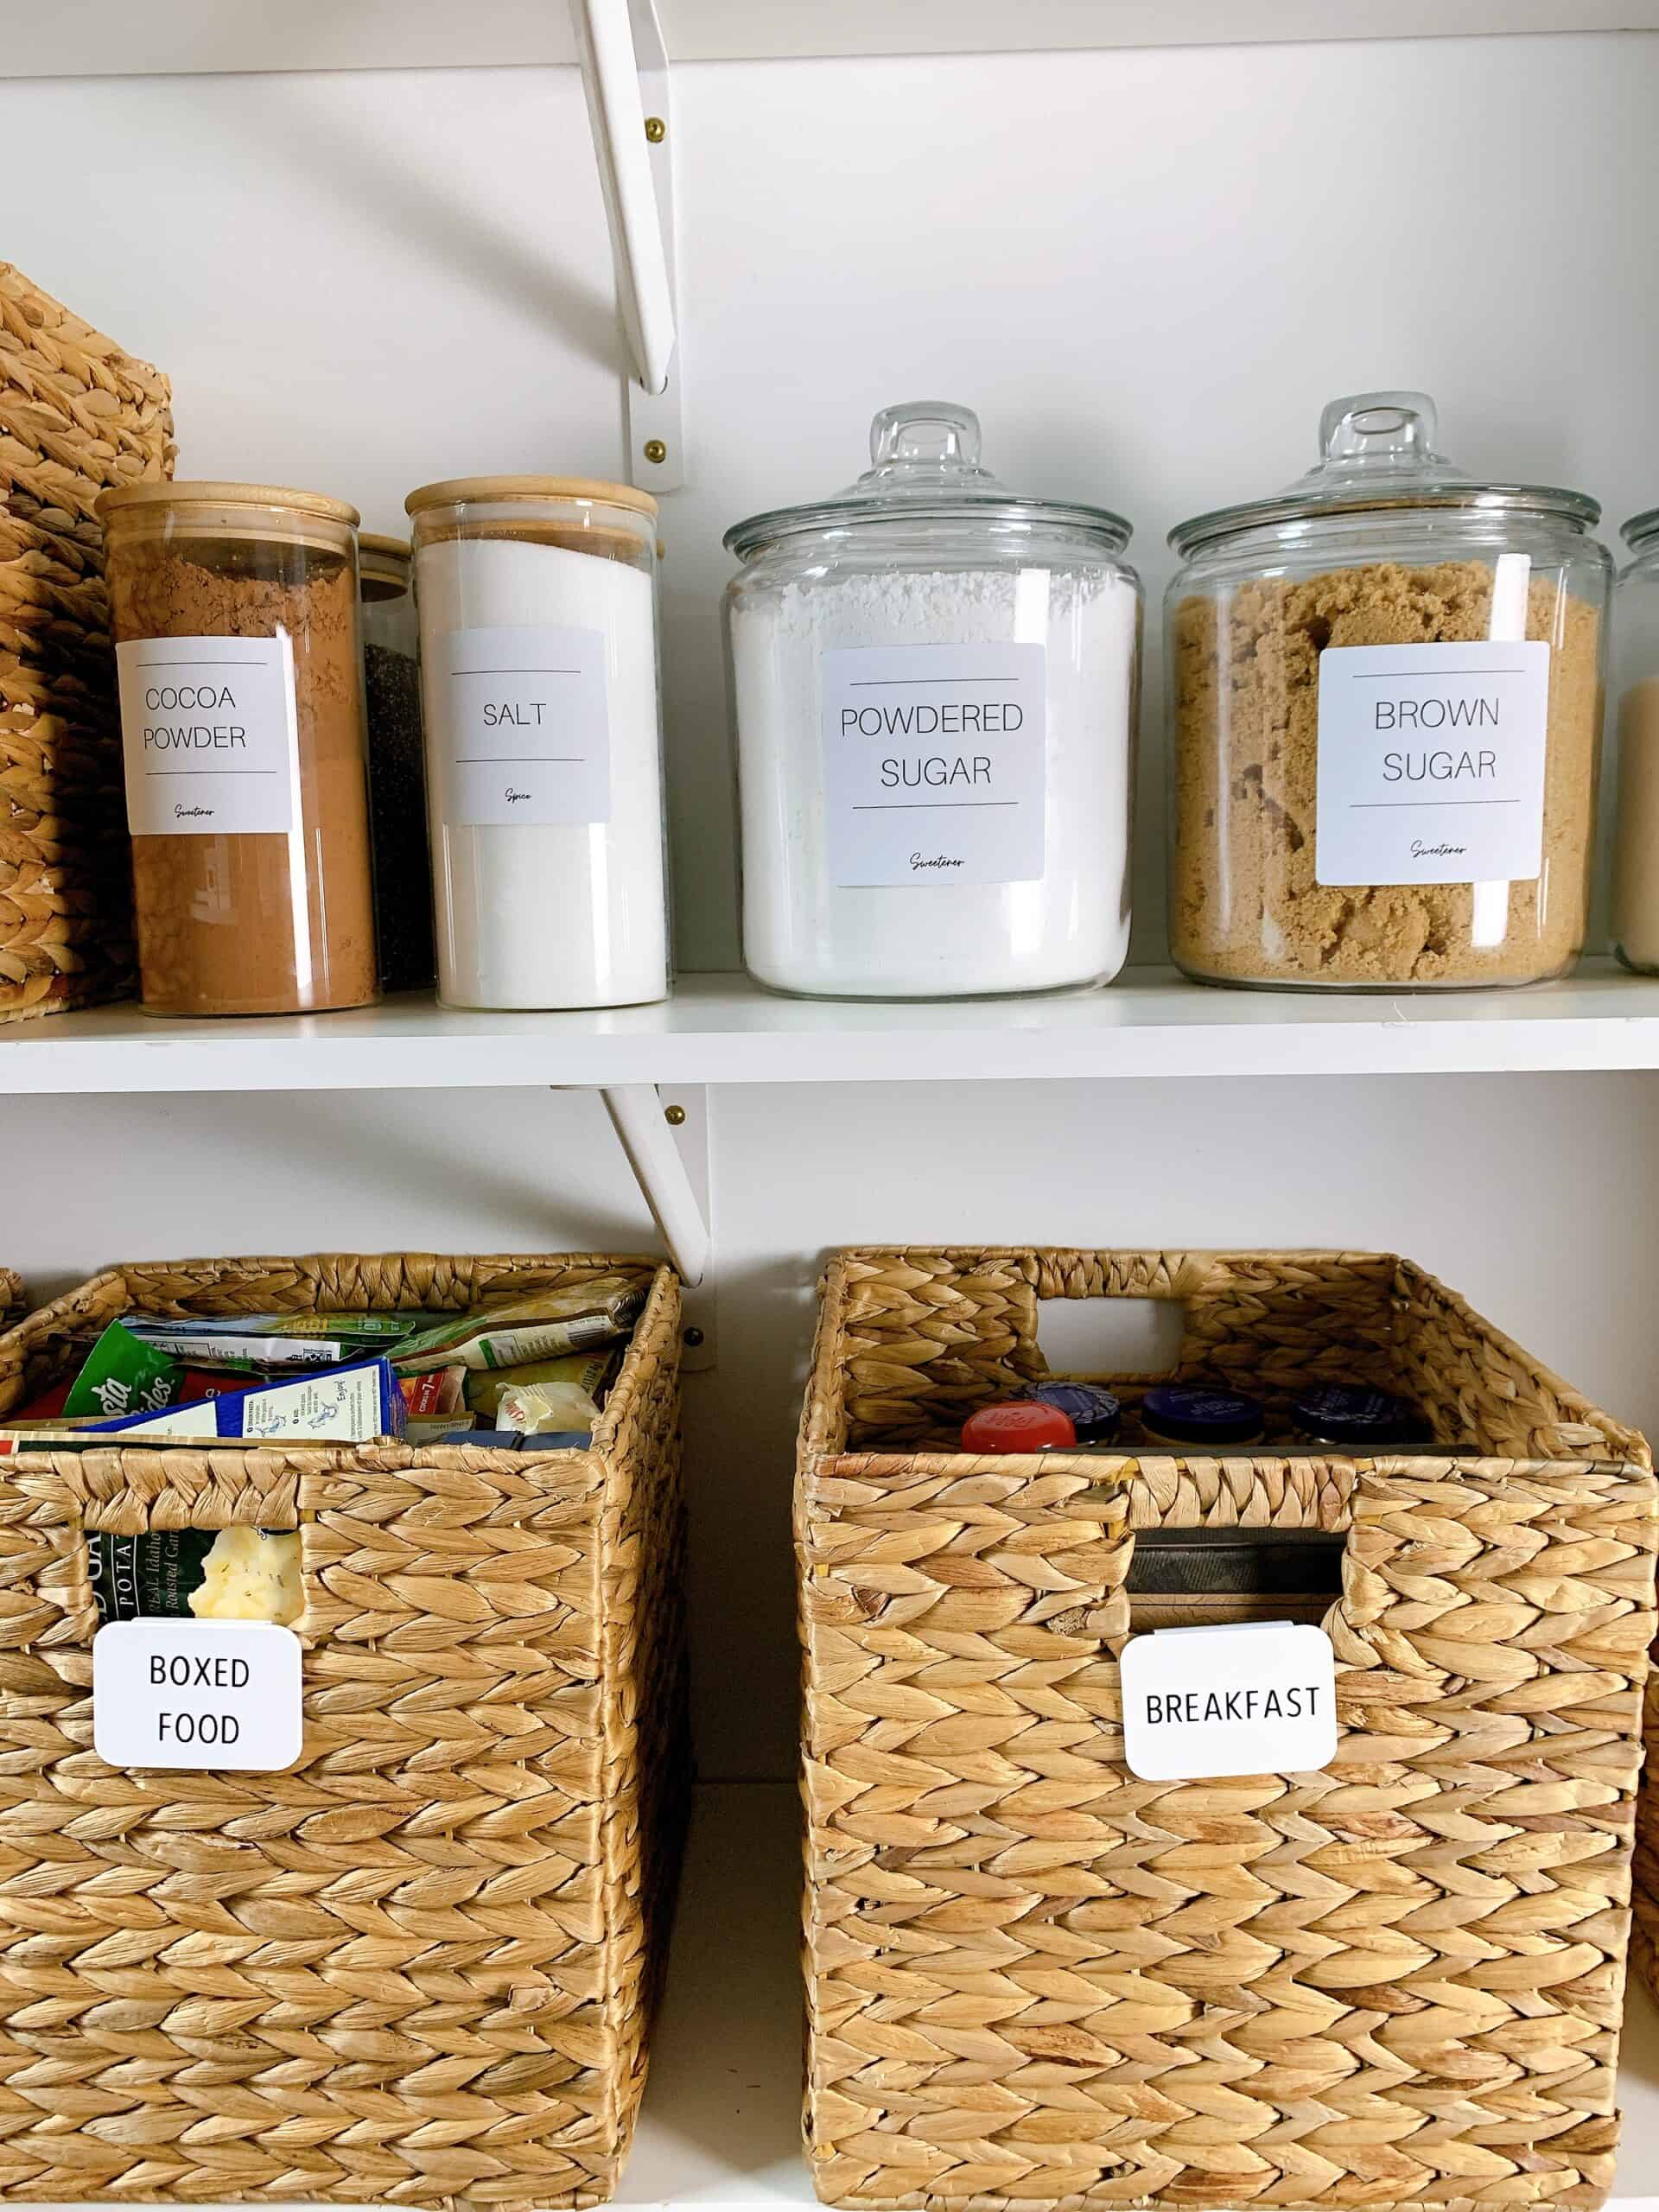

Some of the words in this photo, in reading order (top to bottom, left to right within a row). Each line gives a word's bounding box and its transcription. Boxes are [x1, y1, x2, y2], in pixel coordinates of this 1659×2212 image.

[144, 686, 236, 711] COCOA
[1375, 697, 1500, 730] BROWN
[482, 702, 547, 727] SALT
[841, 703, 1024, 737] POWDERED
[143, 726, 246, 750] POWDER
[880, 756, 992, 787] SUGAR
[1382, 750, 1497, 781] SUGAR
[174, 803, 215, 818] Sweetener
[505, 787, 532, 804] Spice
[909, 852, 966, 871] Sweetener
[1410, 839, 1468, 858] Sweetener
[91, 1377, 131, 1415] sta
[116, 1535, 135, 1606] POTA
[163, 1561, 180, 1610] Roasted
[149, 1655, 250, 1688] BOXED
[1146, 1686, 1320, 1725] BREAKFAST
[158, 1712, 239, 1745] FOOD
